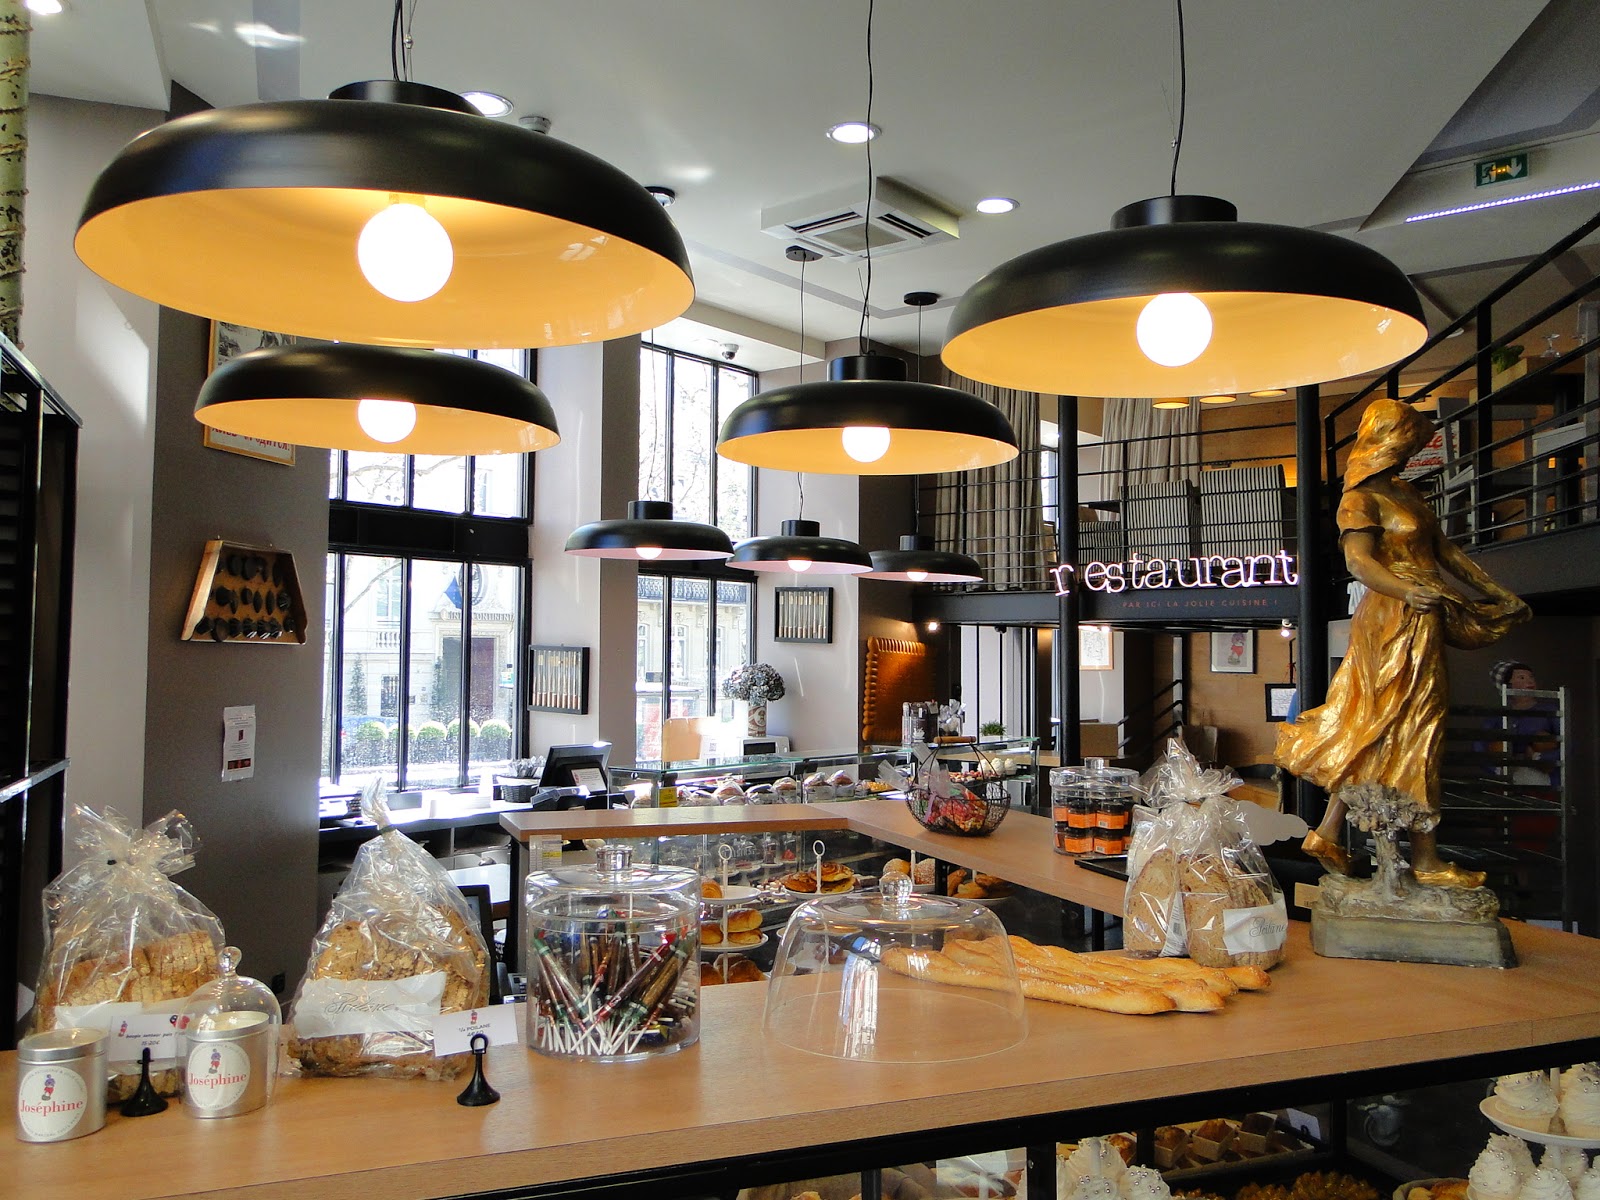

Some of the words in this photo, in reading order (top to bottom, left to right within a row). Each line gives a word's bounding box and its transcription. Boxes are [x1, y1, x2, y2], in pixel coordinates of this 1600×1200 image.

[1167, 600, 1178, 608] LA
[1221, 599, 1267, 607] CUISINE
[189, 1072, 247, 1090] Joséphine
[20, 1099, 84, 1117] Joséphine
